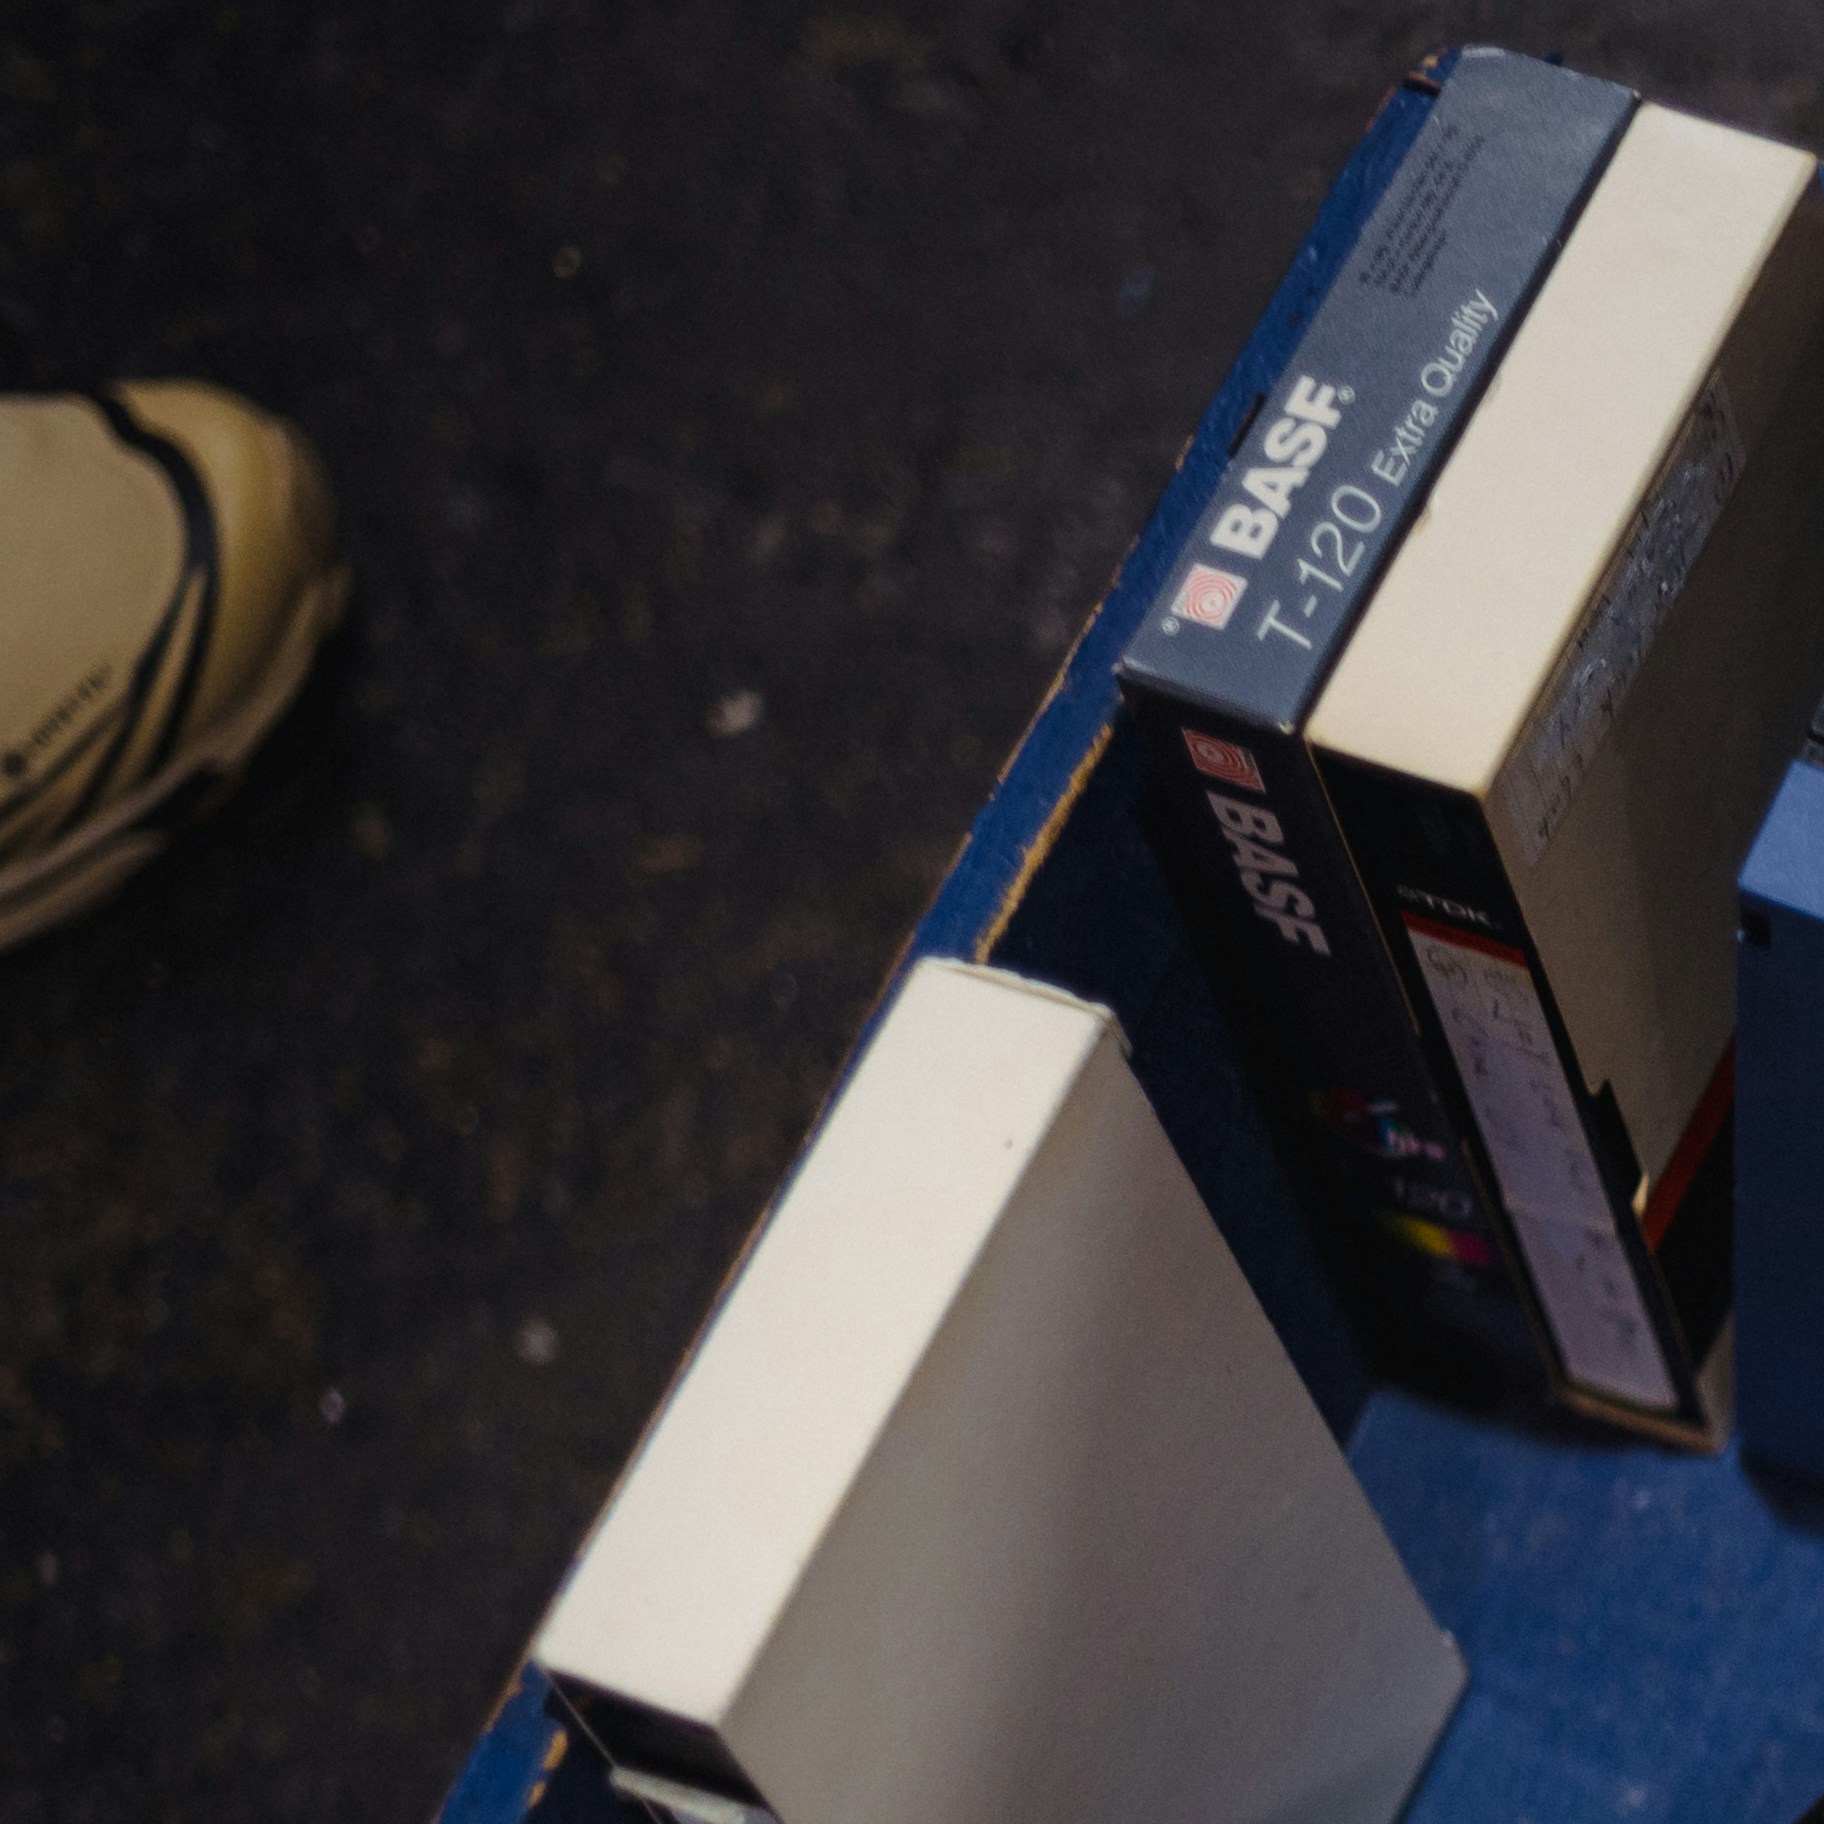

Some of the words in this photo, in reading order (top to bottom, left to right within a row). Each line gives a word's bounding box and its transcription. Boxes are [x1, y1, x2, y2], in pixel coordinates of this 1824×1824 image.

[1210, 374, 1345, 560] BASF
[1257, 484, 1381, 654] T-120
[1371, 399, 1440, 488] Extra
[1420, 288, 1499, 396] Quality
[1204, 789, 1331, 958] BASF
[1421, 892, 1494, 929] TDK
